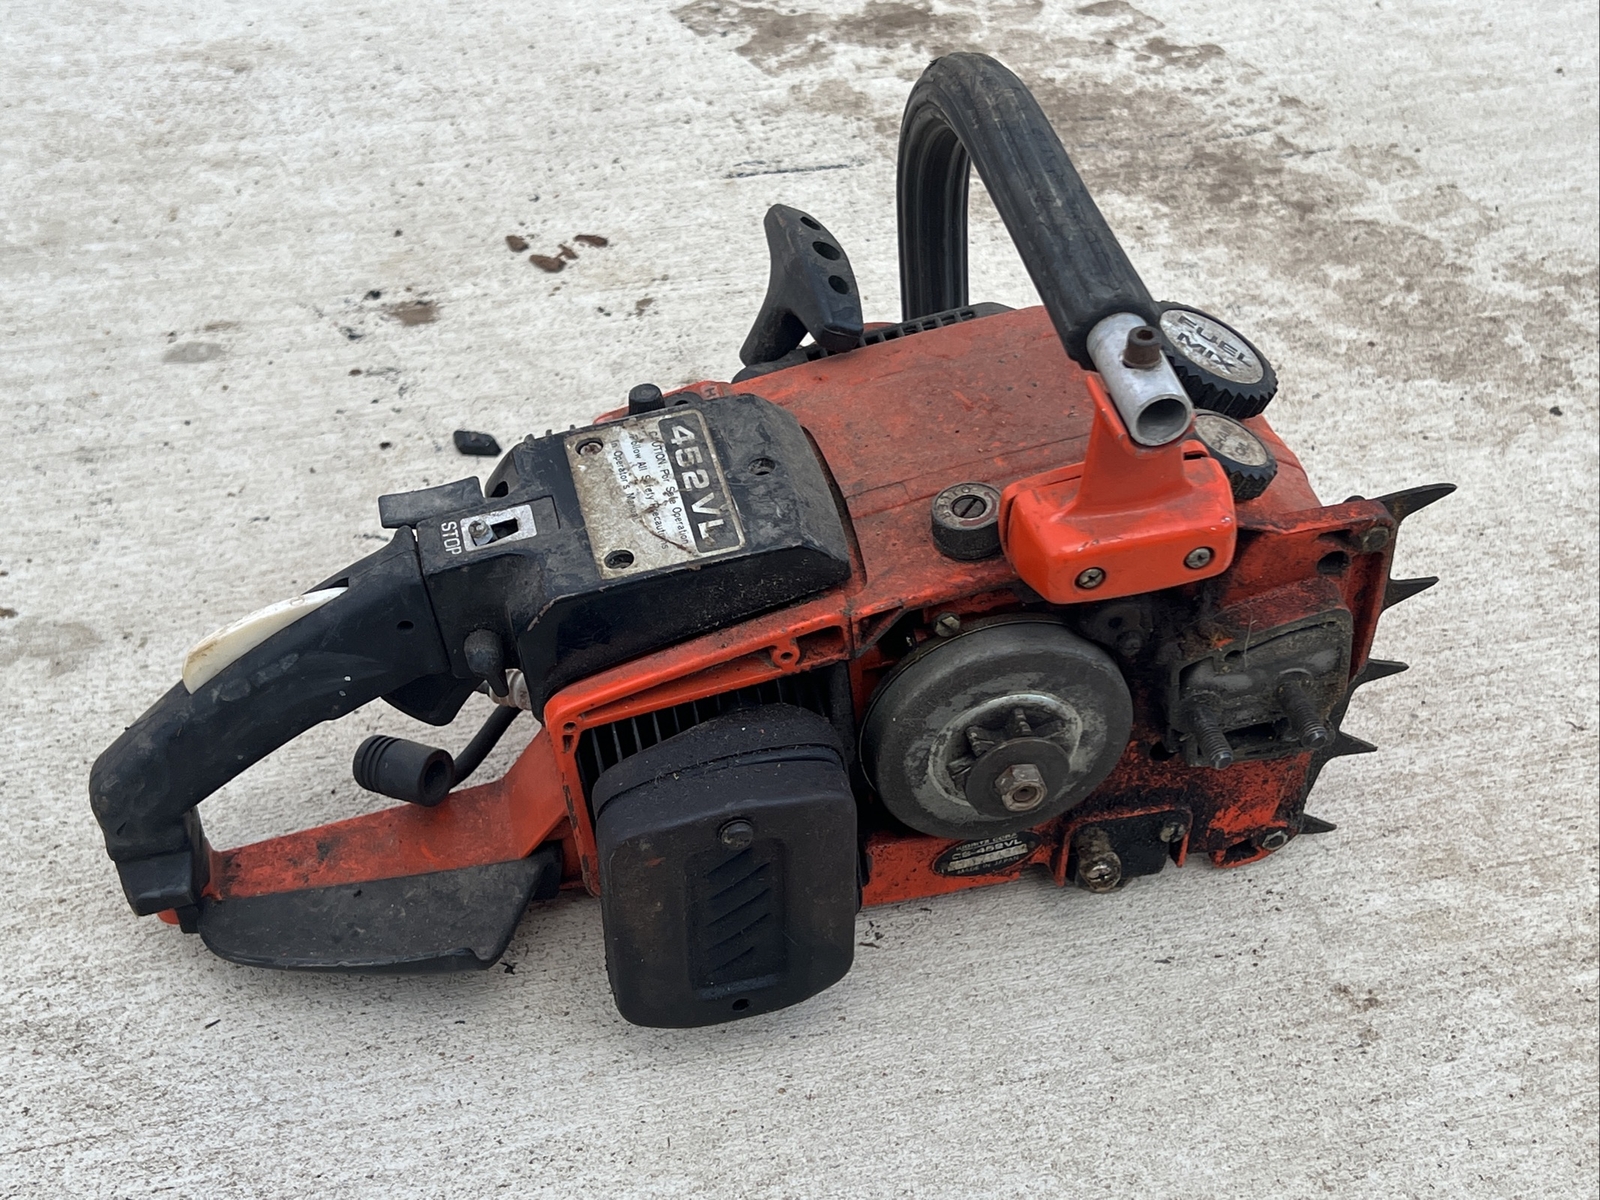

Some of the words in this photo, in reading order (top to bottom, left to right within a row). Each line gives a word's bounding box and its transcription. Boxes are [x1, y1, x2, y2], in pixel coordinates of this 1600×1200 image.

[1177, 331, 1236, 374] MIX
[1178, 315, 1252, 368] FUEL
[636, 461, 647, 471] All
[671, 425, 725, 543] 452VL
[641, 475, 655, 501] Sfety
[441, 521, 463, 555] STOP
[672, 505, 690, 544] Operation
